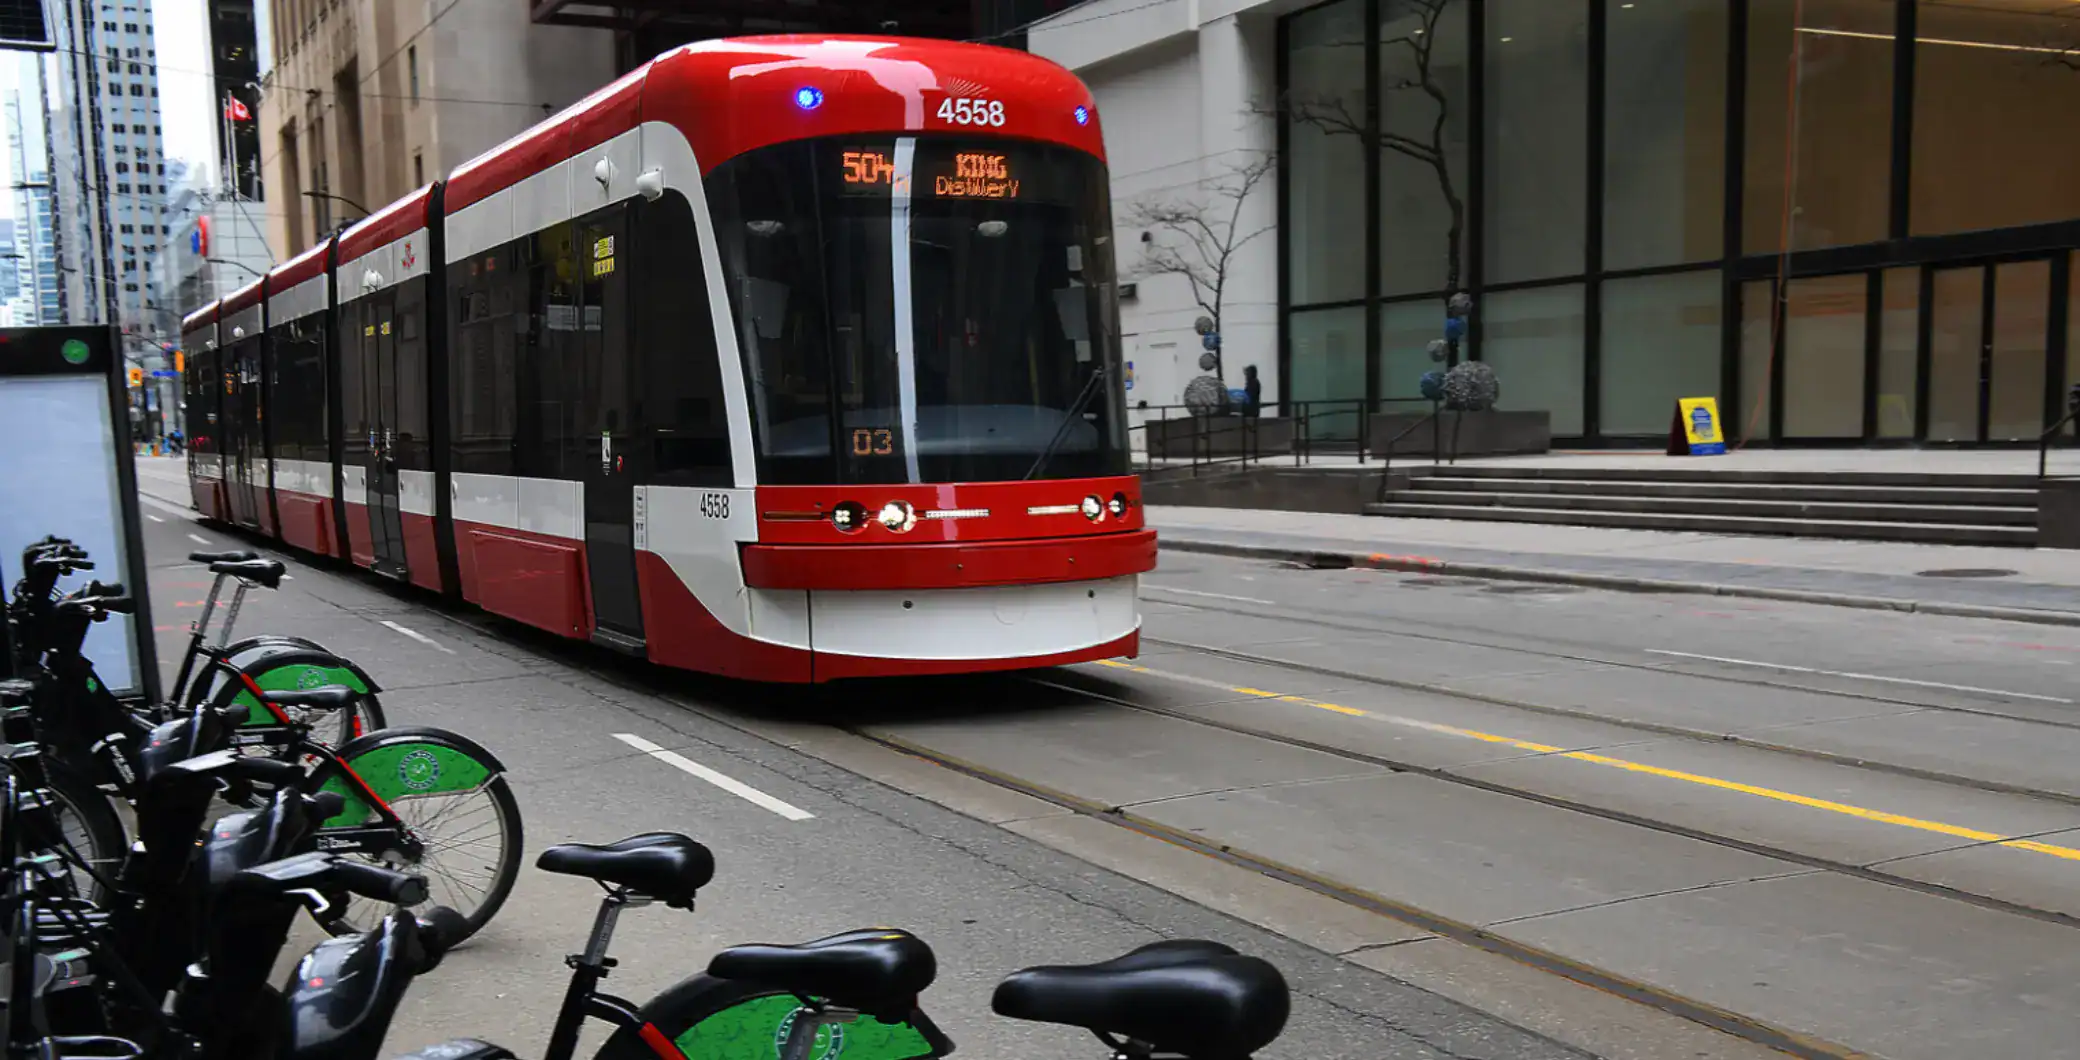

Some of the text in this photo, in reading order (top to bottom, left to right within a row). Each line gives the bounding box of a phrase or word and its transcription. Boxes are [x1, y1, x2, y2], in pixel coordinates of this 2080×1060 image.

[937, 97, 1005, 127] 4558
[956, 153, 1007, 179] KING
[853, 429, 892, 455] 03
[700, 493, 730, 519] 4558
